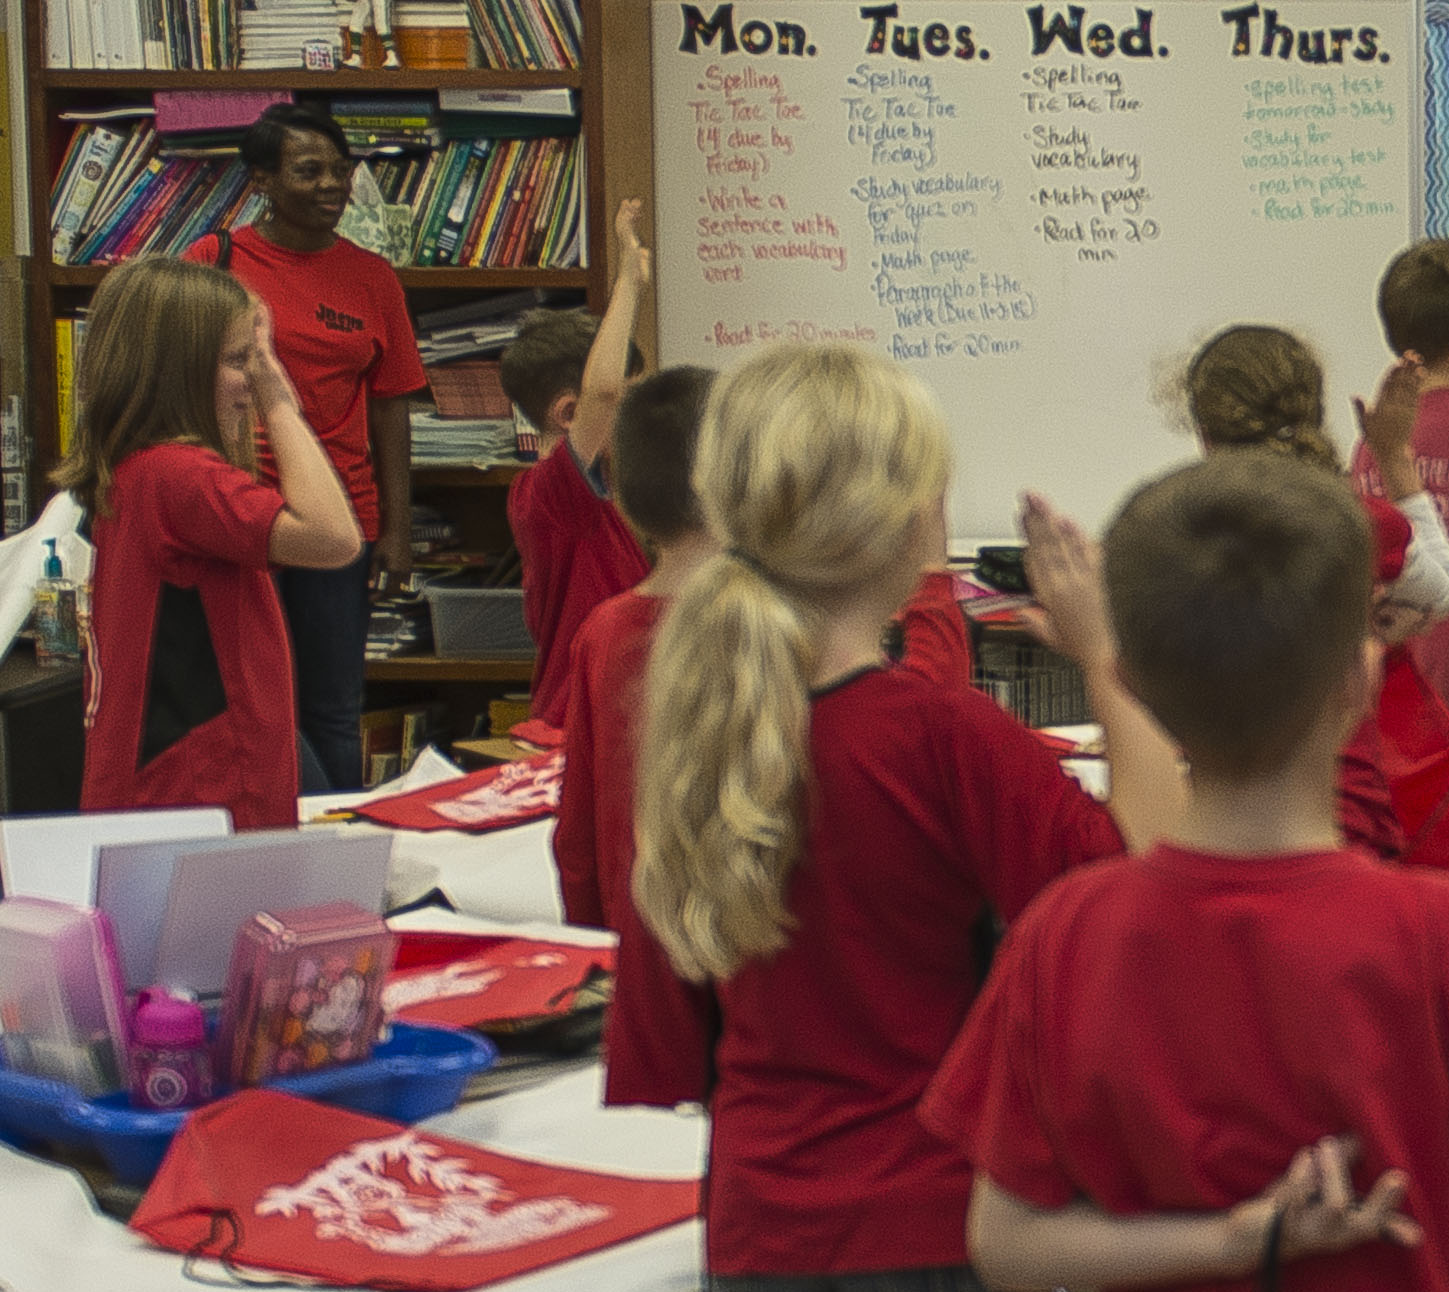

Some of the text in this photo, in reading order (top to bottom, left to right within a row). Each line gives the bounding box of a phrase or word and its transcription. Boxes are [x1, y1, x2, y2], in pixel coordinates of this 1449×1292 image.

[678, 3, 817, 56] Mon.
[860, 3, 990, 61] Tues.
[1026, 4, 1169, 57] Wed.
[1221, 4, 1390, 64] Thurs.
[706, 64, 783, 98] Spelling
[856, 64, 933, 98] Spelling
[1122, 217, 1159, 242] 20
